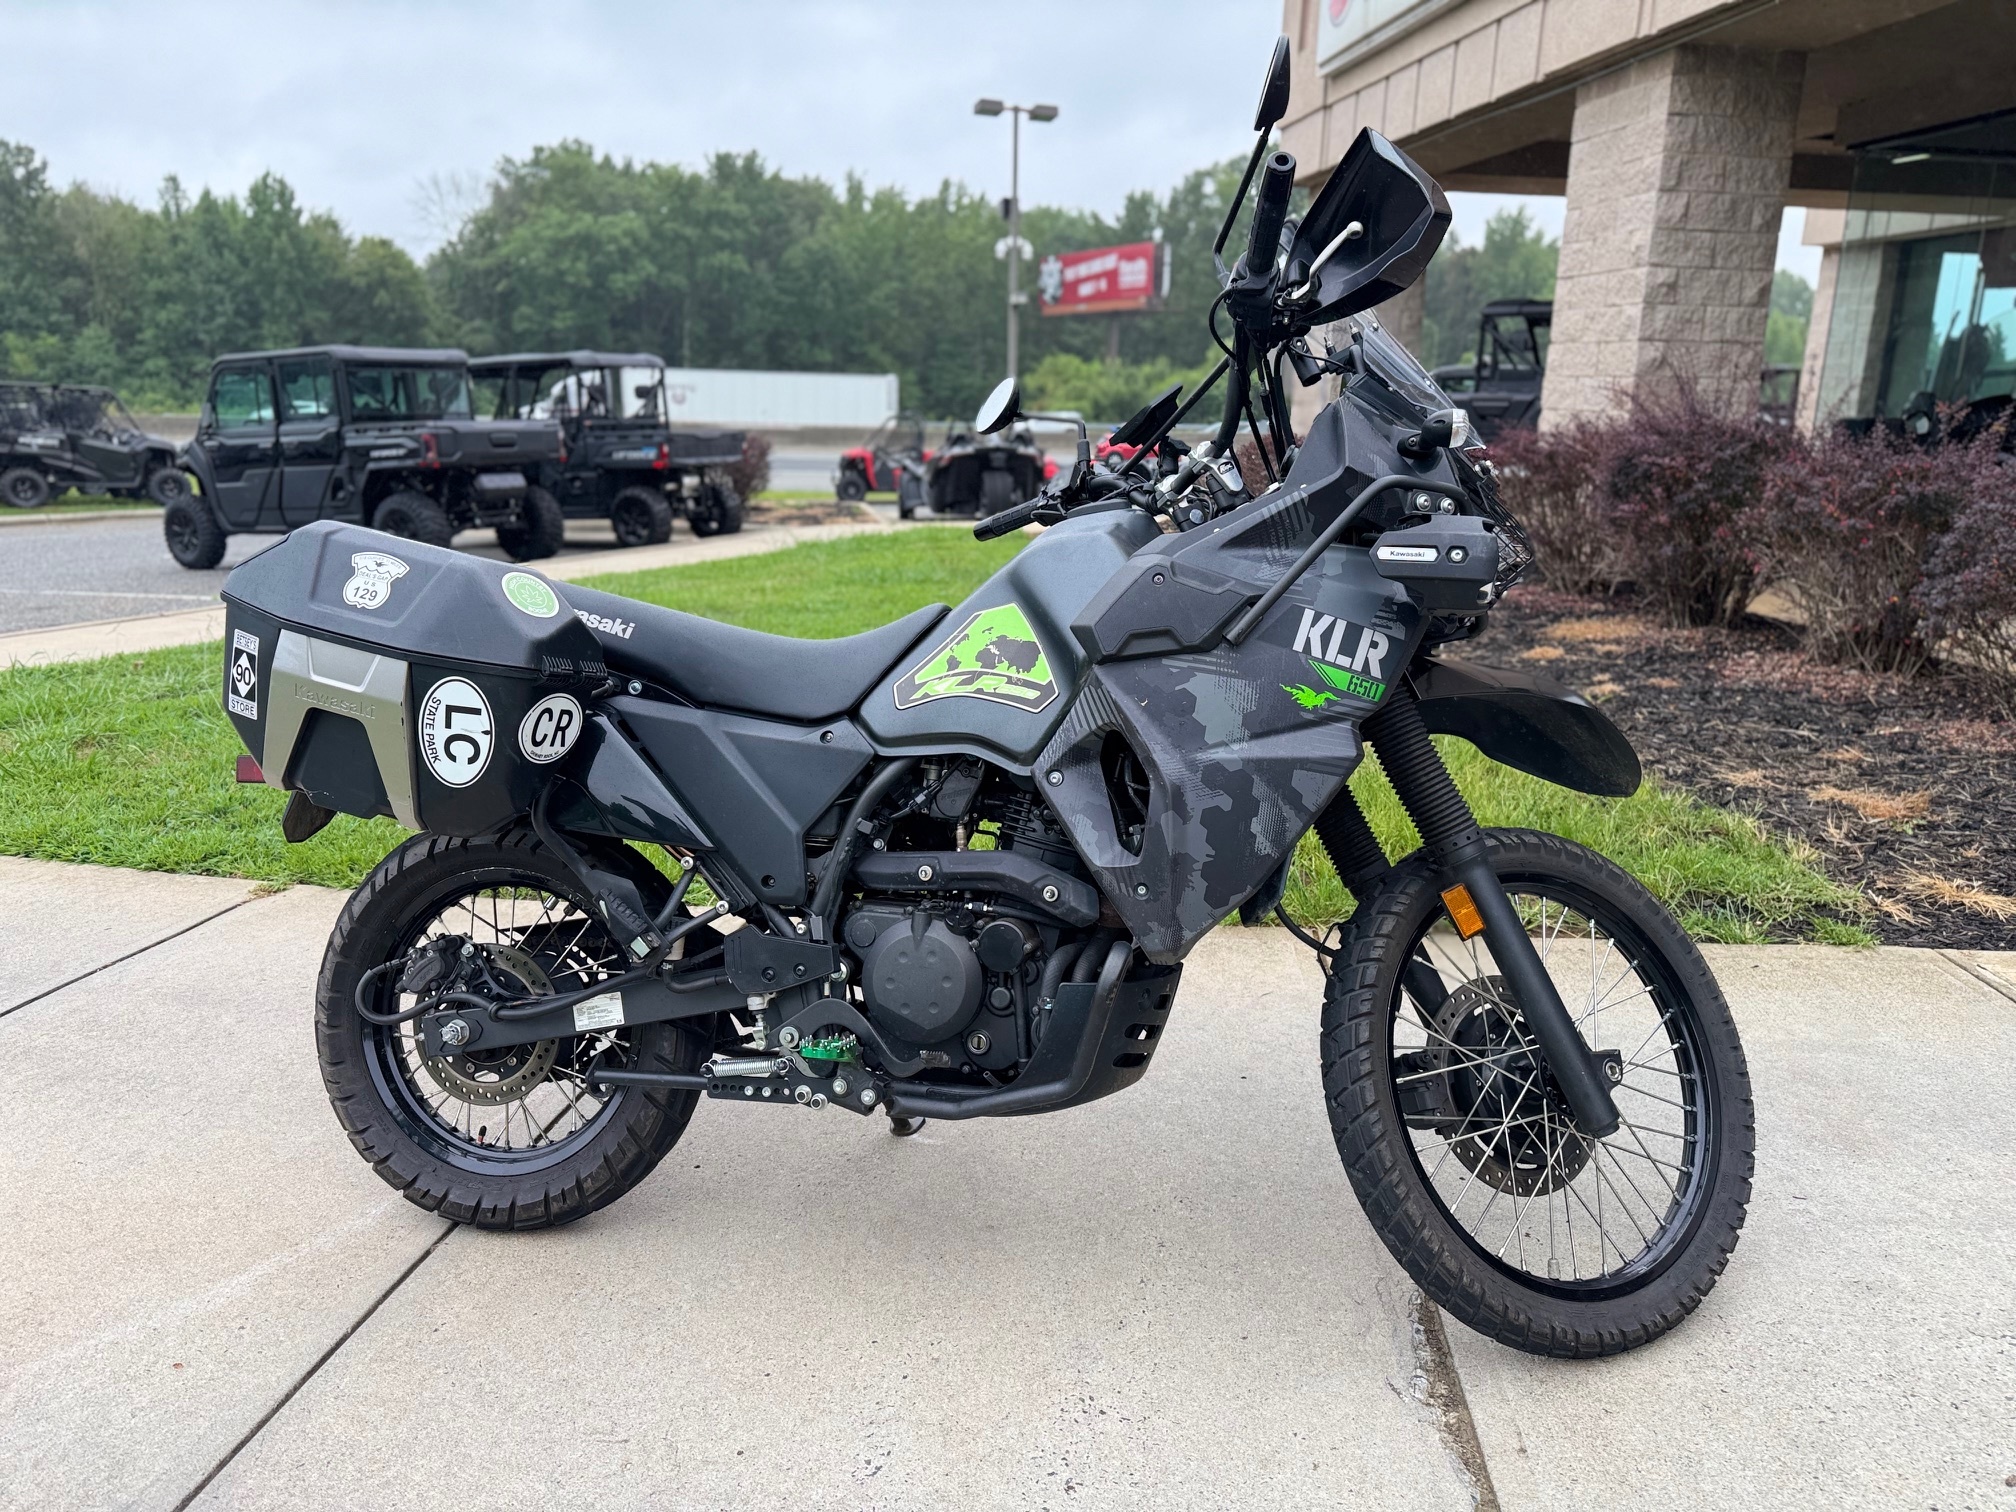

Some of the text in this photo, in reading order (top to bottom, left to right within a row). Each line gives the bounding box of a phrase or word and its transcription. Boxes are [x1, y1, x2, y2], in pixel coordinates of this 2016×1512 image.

[1390, 550, 1426, 558] Kawasaki
[353, 586, 378, 602] 129
[516, 576, 548, 592] COUNTRY
[574, 608, 636, 640] asaki
[1292, 608, 1390, 680] KLR
[235, 663, 252, 687] 90
[908, 675, 1007, 701] KLR
[1346, 674, 1380, 700] 650
[231, 699, 255, 716] STORE
[294, 682, 376, 720] Kawasaki
[425, 696, 442, 764] STATE PARK
[443, 704, 482, 766] LC
[531, 706, 574, 748] CR
